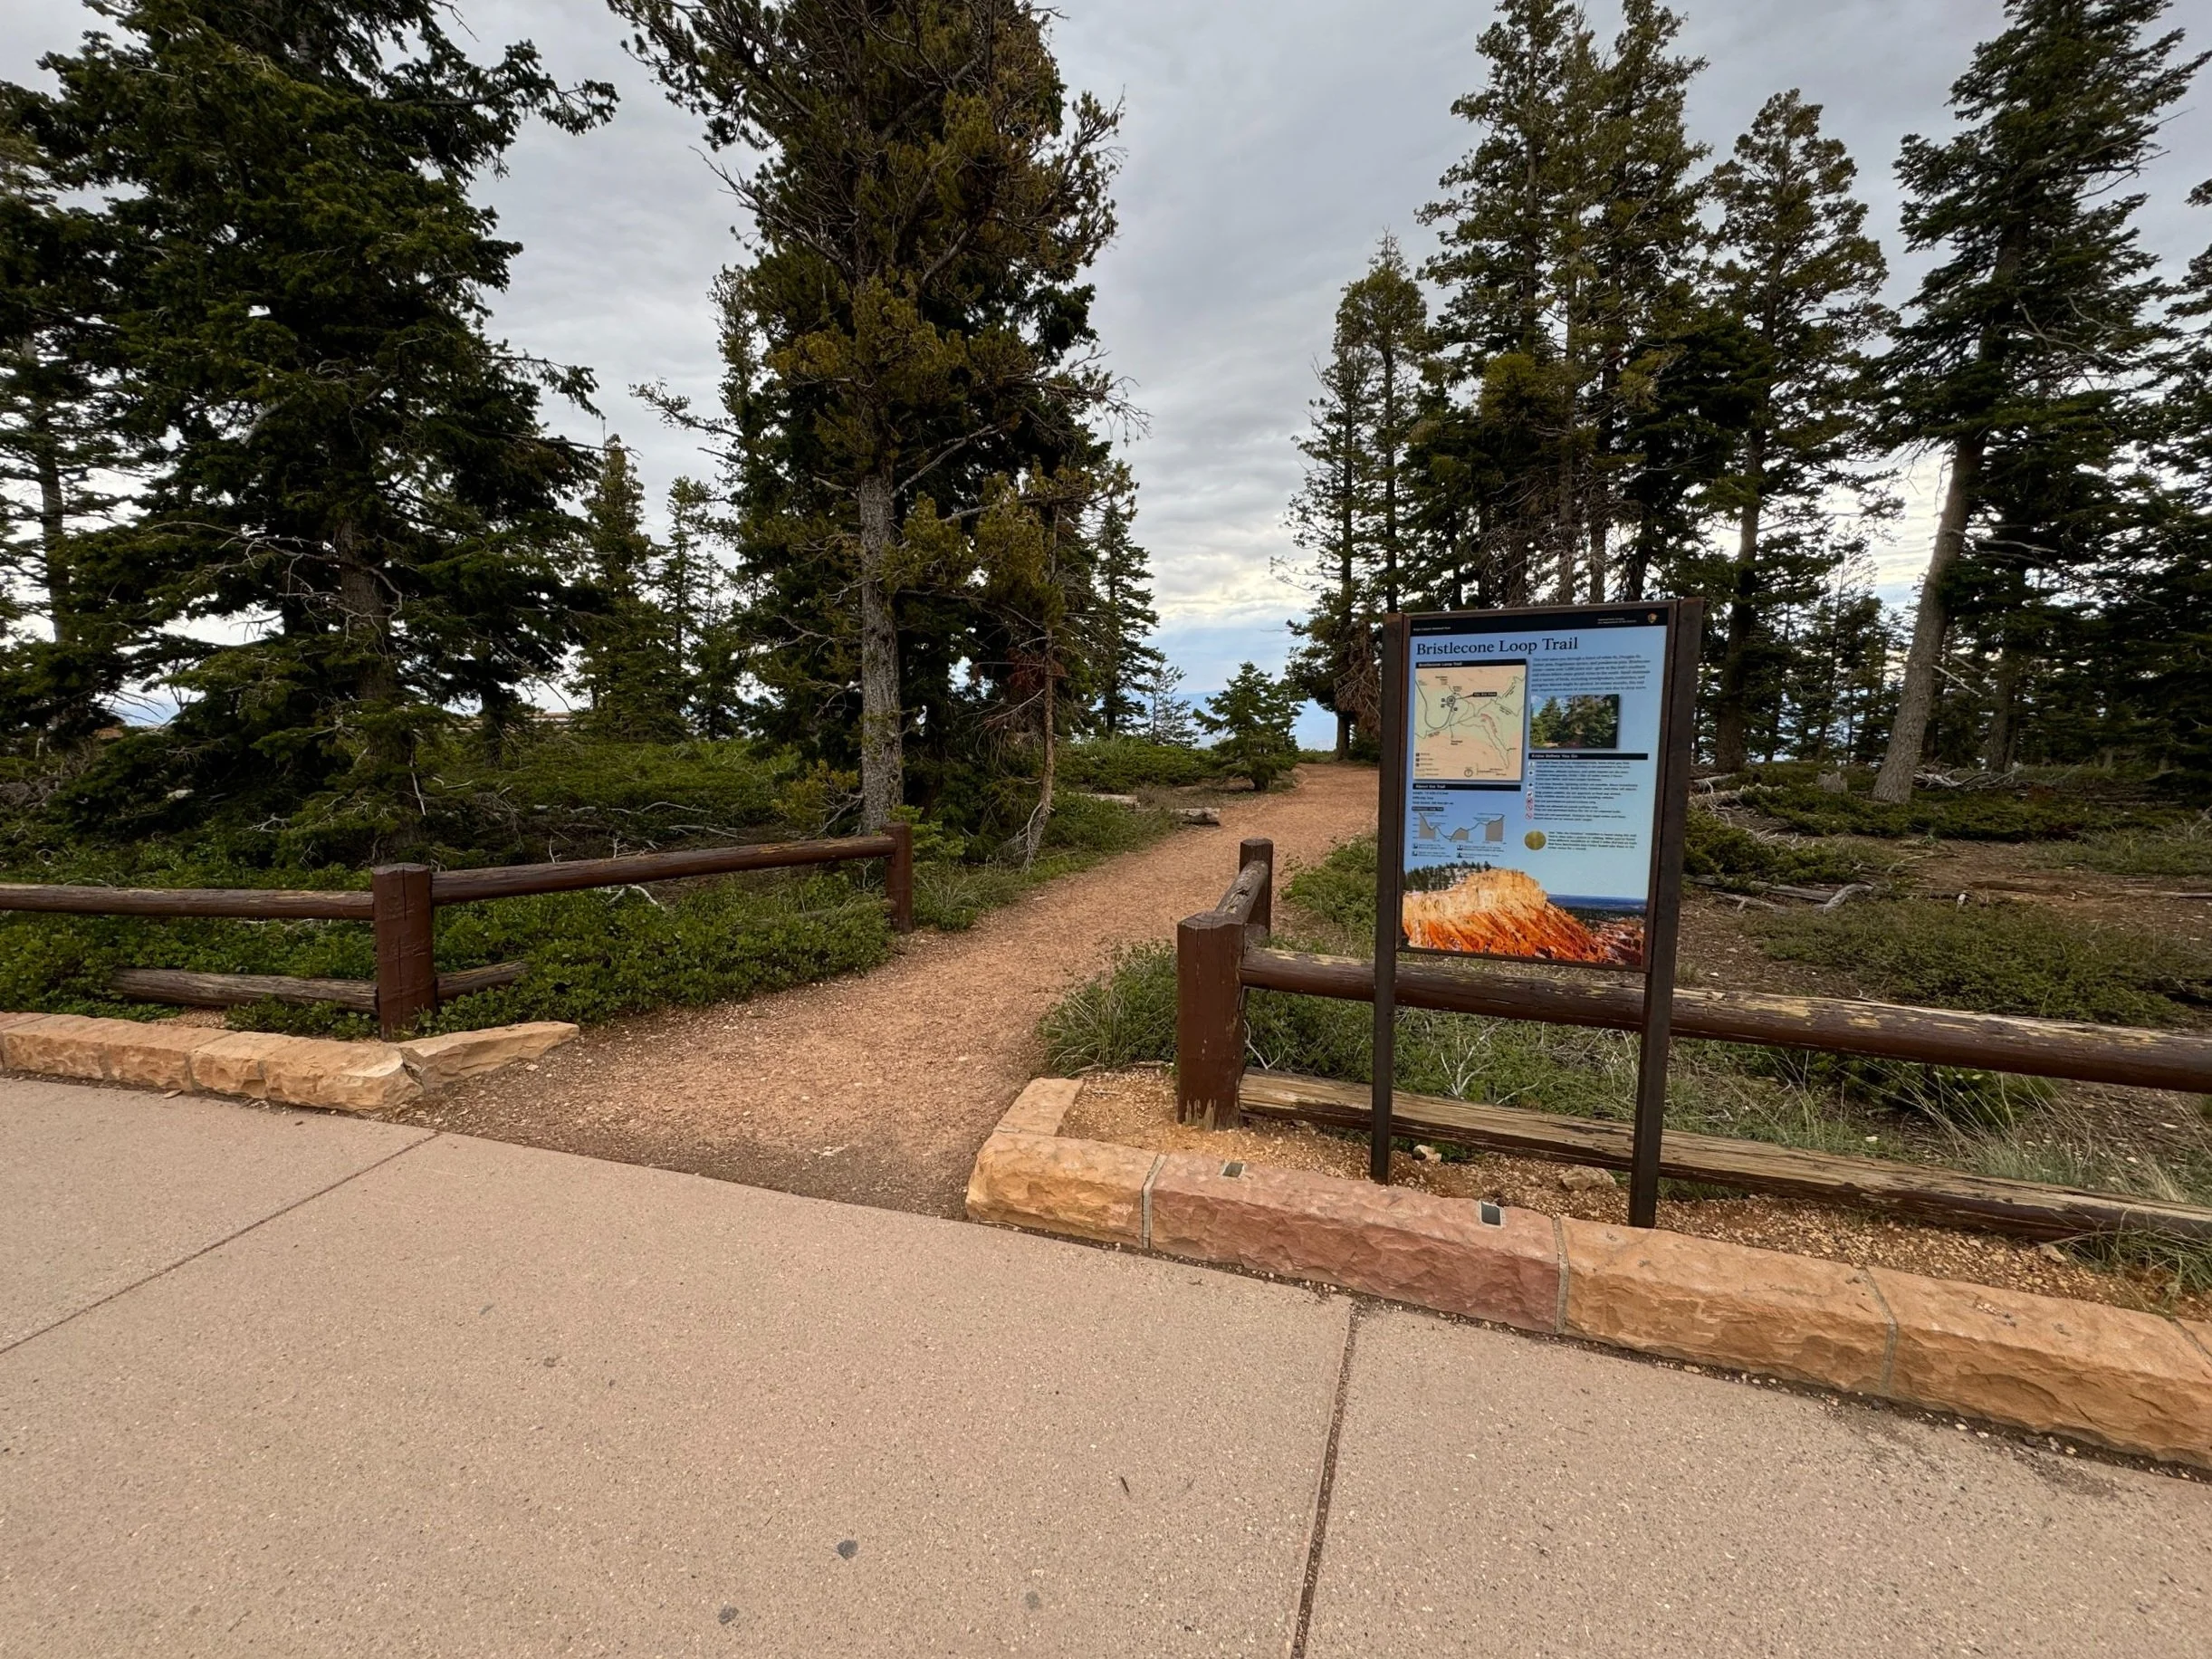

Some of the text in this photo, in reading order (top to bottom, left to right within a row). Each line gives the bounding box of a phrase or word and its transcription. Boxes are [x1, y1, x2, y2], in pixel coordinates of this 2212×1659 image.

[1416, 638, 1578, 656] Bristlecone Loop Trail
